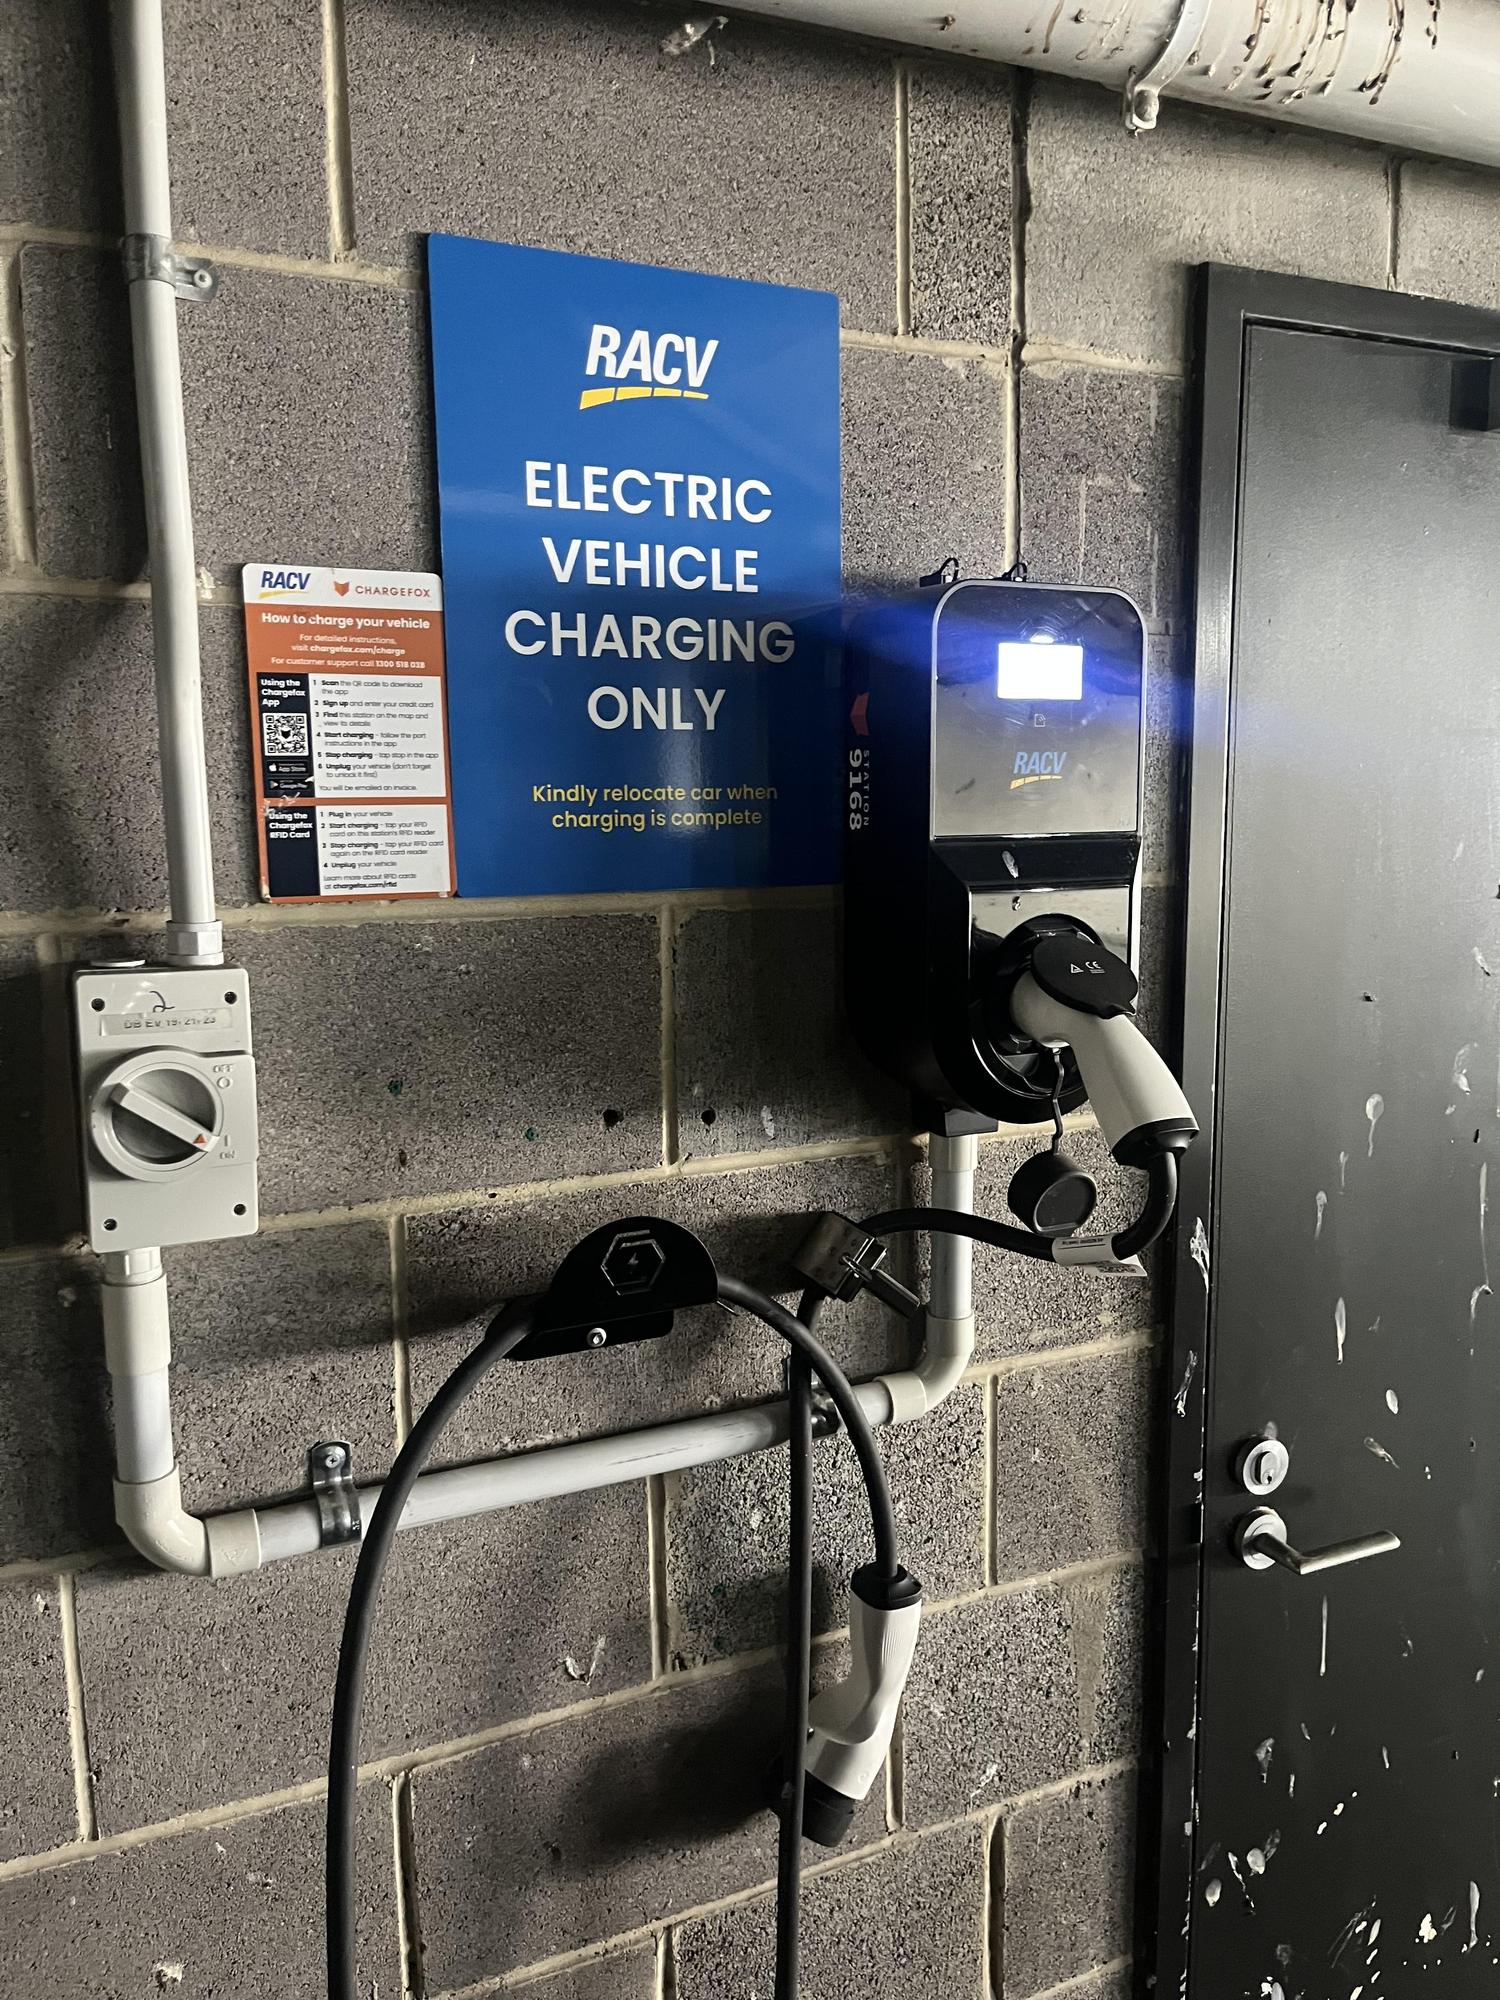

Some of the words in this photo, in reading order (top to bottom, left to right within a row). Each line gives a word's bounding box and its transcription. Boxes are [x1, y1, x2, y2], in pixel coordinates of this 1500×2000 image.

[586, 324, 718, 387] RACV
[525, 460, 772, 524] ELECTRIC
[542, 537, 758, 593] VEHICLE
[261, 571, 310, 590] RACV
[355, 585, 430, 597] CHARGEFOX
[262, 612, 289, 624] How
[294, 614, 306, 624] to
[309, 615, 353, 628] charge
[356, 619, 384, 629] your
[386, 617, 430, 629] vehicle
[505, 610, 795, 664] CHARGING
[310, 645, 405, 656] chargefox.com/charge
[327, 659, 358, 668] support
[261, 679, 285, 688] Using
[261, 688, 305, 698] Chargefox
[262, 699, 280, 707] App
[587, 686, 726, 731] ONLY
[1014, 751, 1068, 774] RACV
[532, 784, 597, 807] Kindly
[604, 785, 686, 801] relocate
[691, 788, 722, 801] car
[727, 784, 777, 800] when
[850, 749, 862, 830] 9168
[269, 812, 292, 821] Using
[269, 822, 313, 830] Chargefox
[552, 810, 645, 833] charging
[651, 809, 666, 826] is
[672, 809, 762, 830] complete
